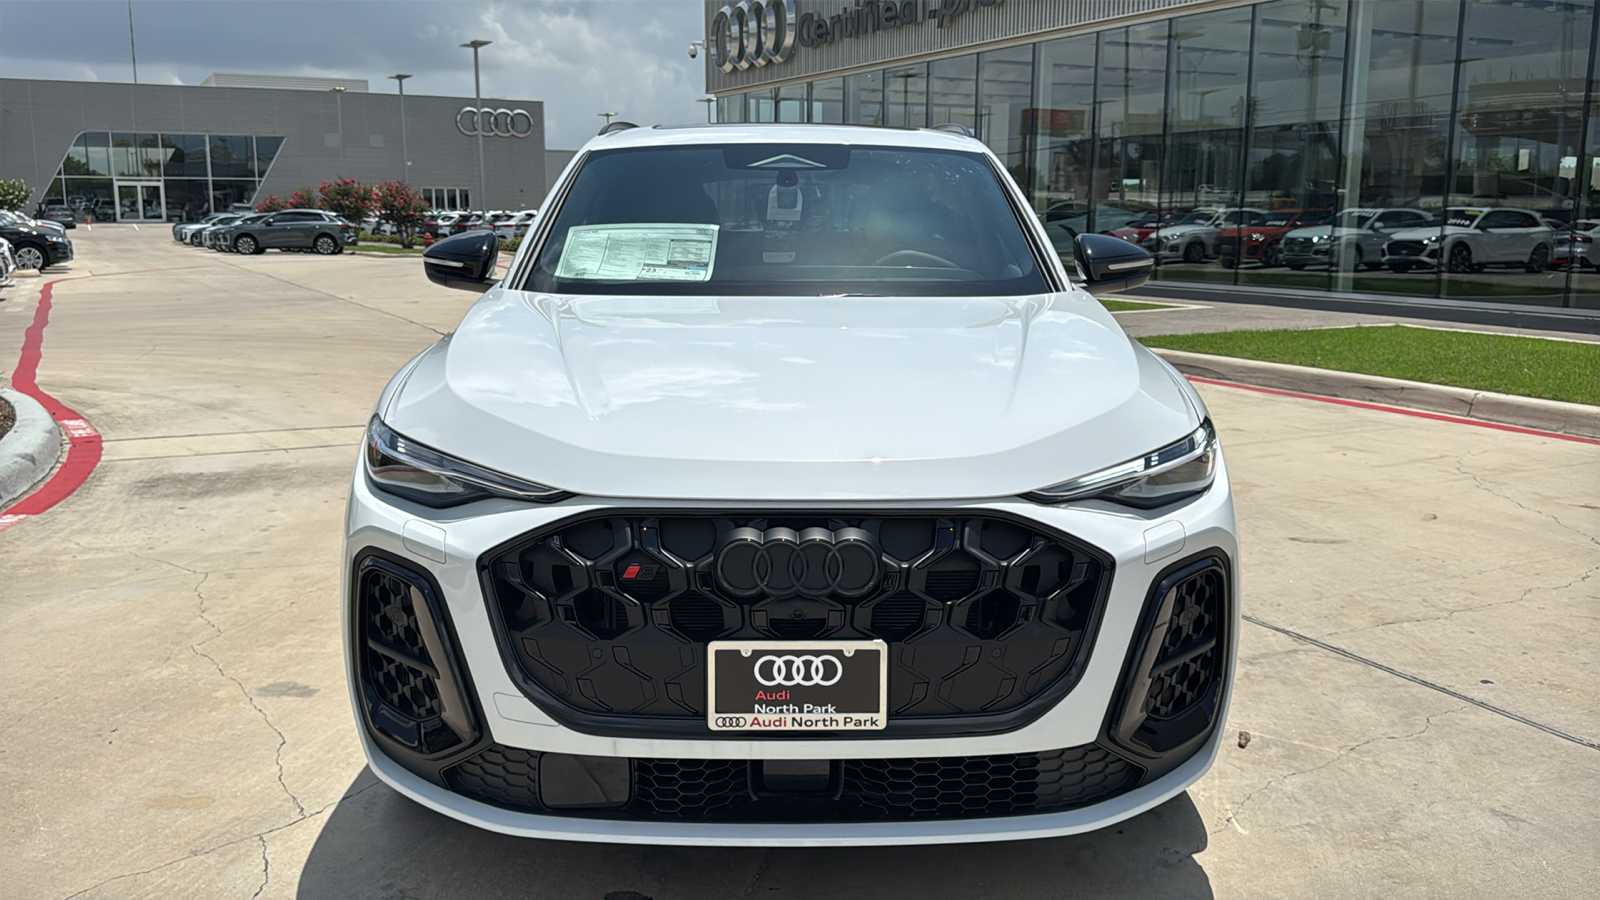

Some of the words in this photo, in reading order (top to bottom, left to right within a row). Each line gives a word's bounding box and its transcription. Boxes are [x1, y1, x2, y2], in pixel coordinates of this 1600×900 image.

[799, 0, 923, 48] Certified
[755, 690, 791, 701] Audi
[754, 703, 799, 714] North
[803, 703, 837, 714] Park
[749, 716, 788, 728] Audi
[791, 716, 839, 728] North
[843, 716, 880, 728] Park
